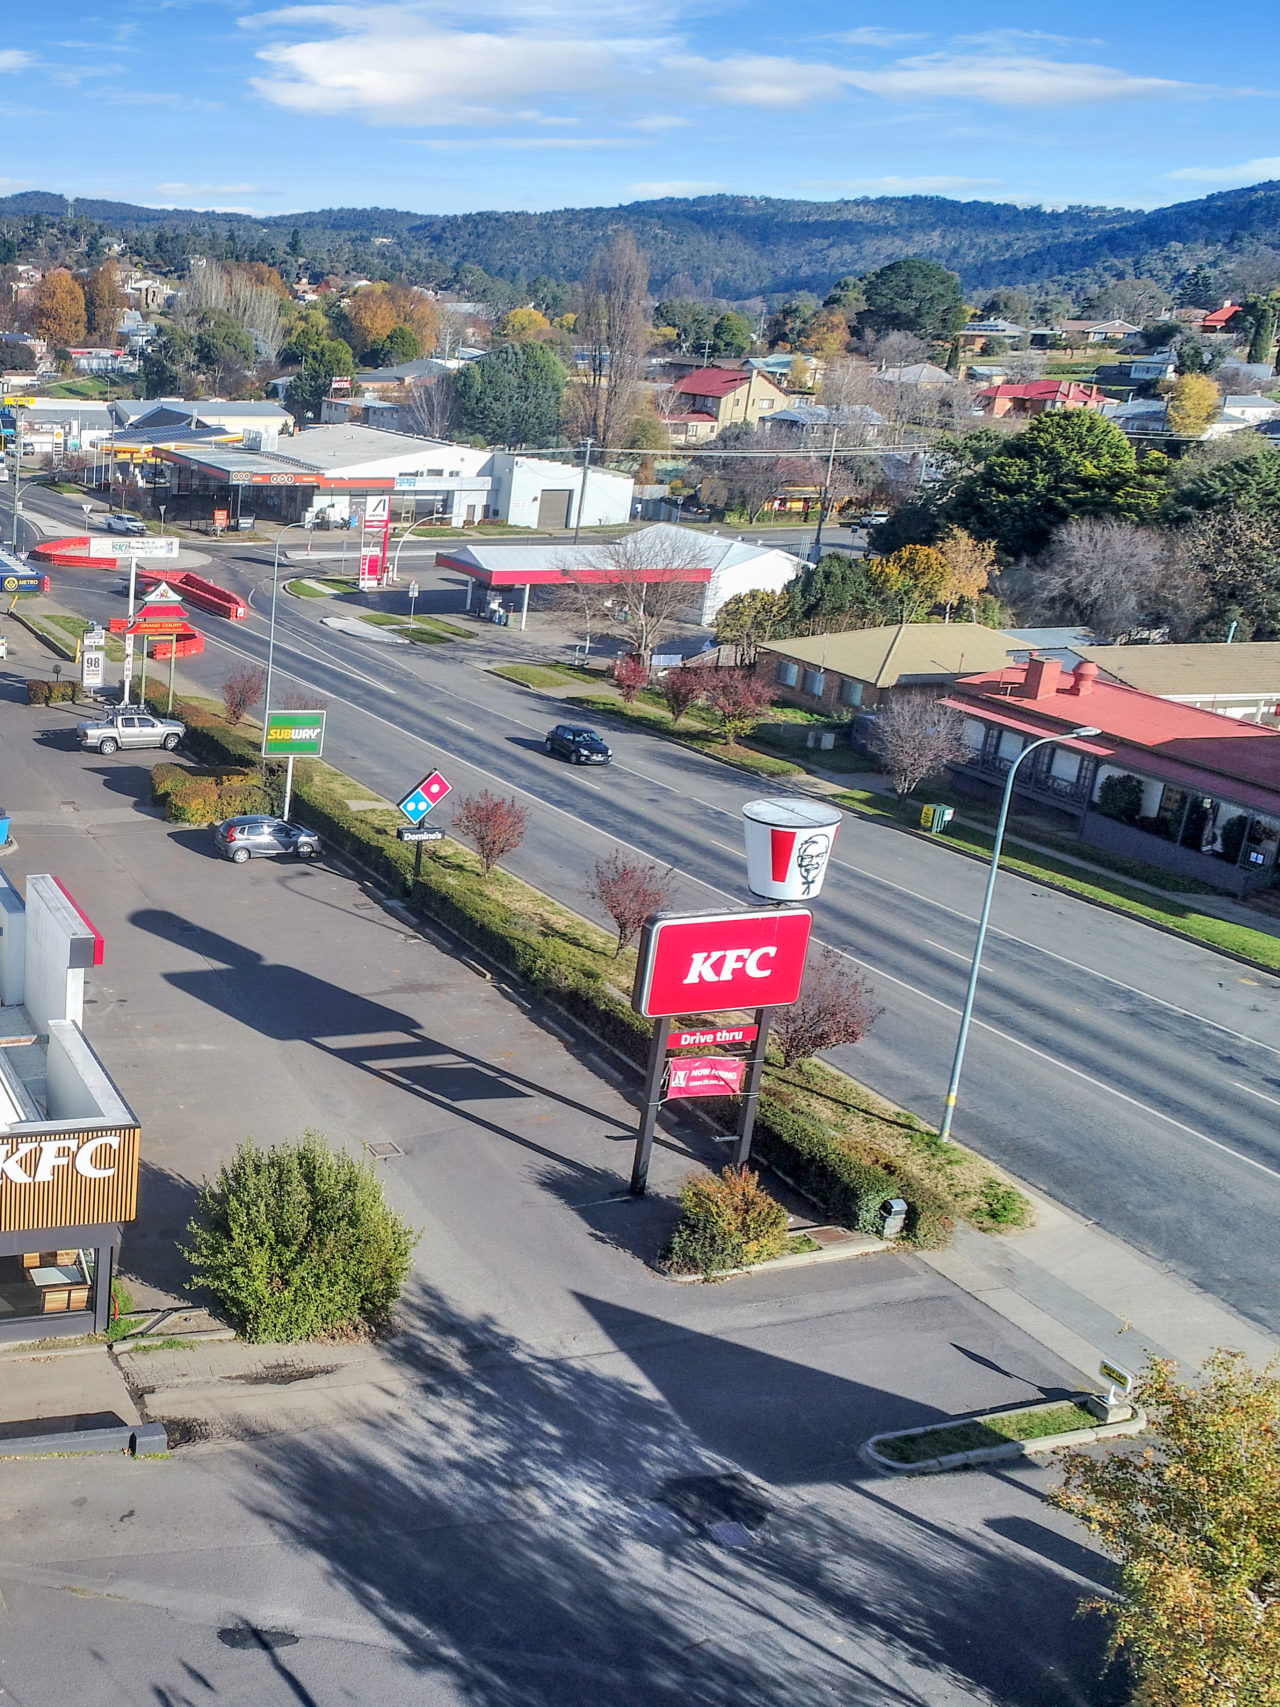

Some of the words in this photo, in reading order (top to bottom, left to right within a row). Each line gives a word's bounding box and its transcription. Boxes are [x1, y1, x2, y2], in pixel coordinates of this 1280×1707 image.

[86, 657, 100, 669] 98
[267, 728, 321, 739] SUBWAY
[404, 832, 442, 841] Domino's
[682, 946, 777, 984] KFC
[680, 1033, 714, 1046] Drive
[716, 1029, 743, 1042] thru
[691, 1068, 711, 1076] NOW
